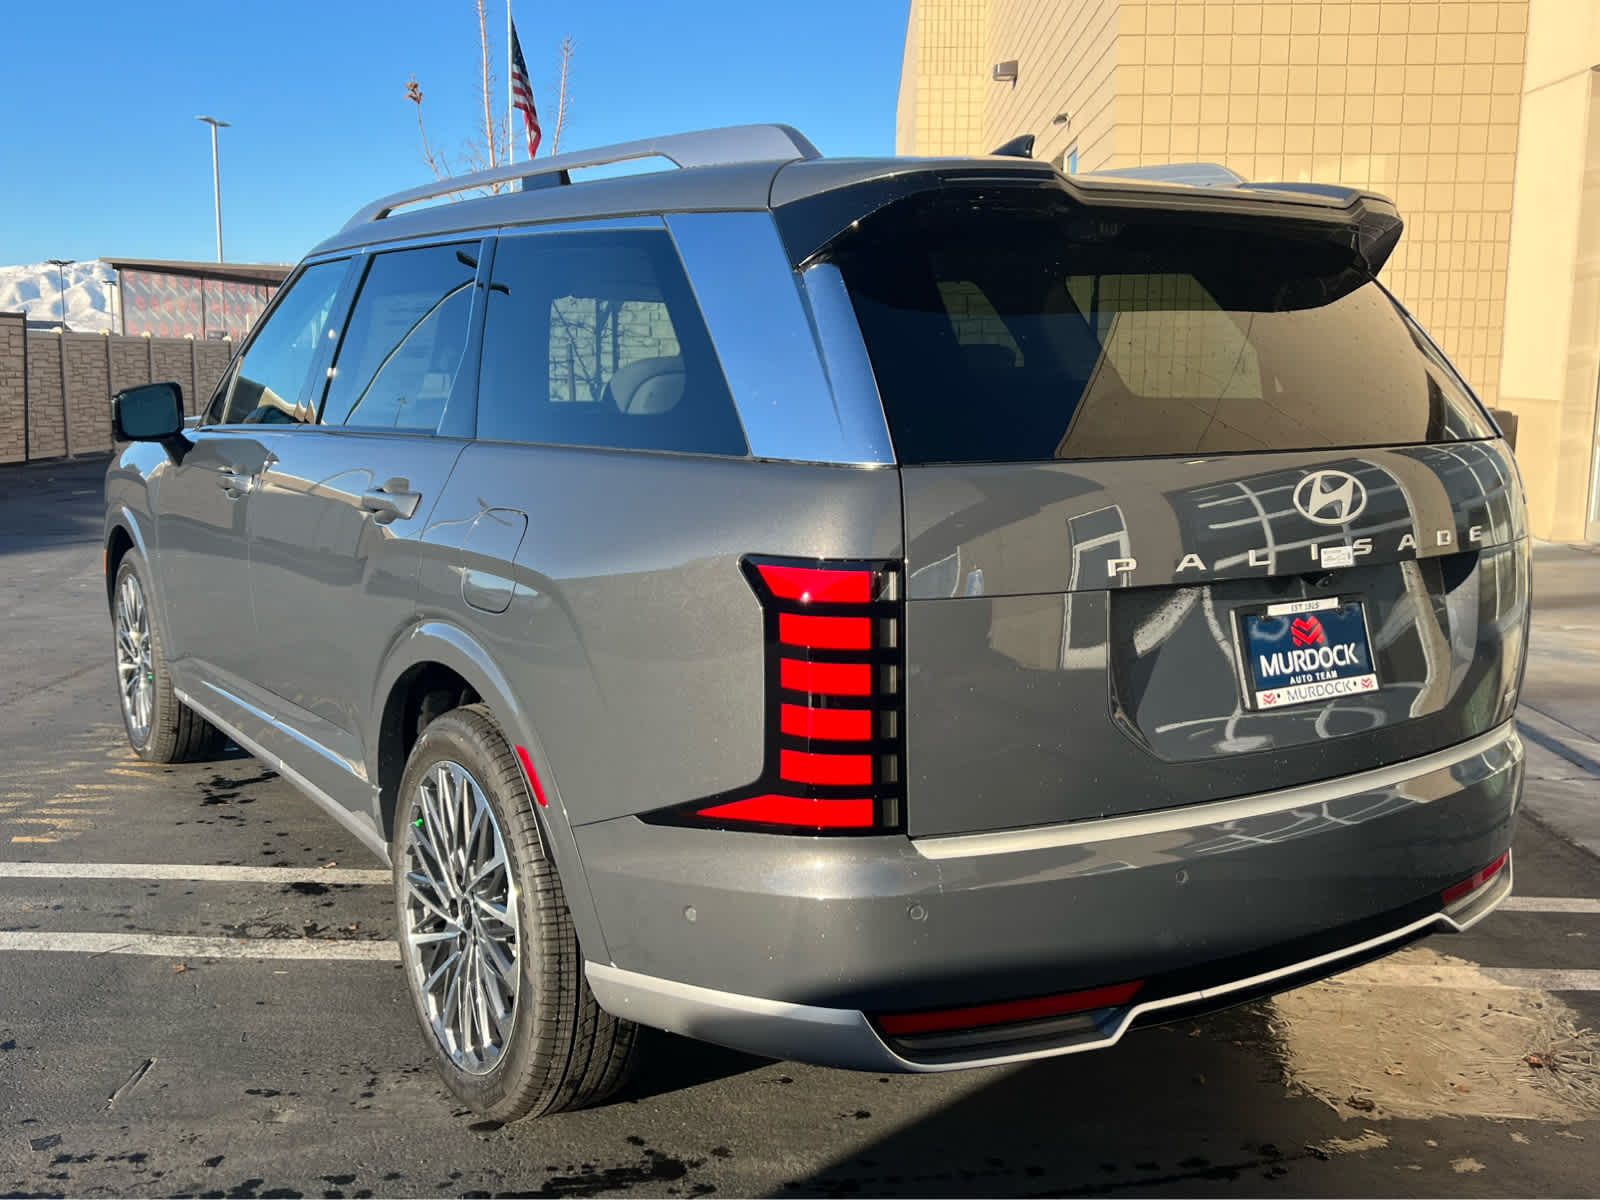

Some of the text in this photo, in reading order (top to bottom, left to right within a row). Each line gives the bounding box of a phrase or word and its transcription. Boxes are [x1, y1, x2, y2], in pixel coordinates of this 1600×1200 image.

[1107, 526, 1482, 577] PALISADE
[1259, 643, 1359, 677] MURDOCK
[1286, 679, 1352, 702] MURDOCK
[1290, 670, 1338, 685] AUTO TEAM
